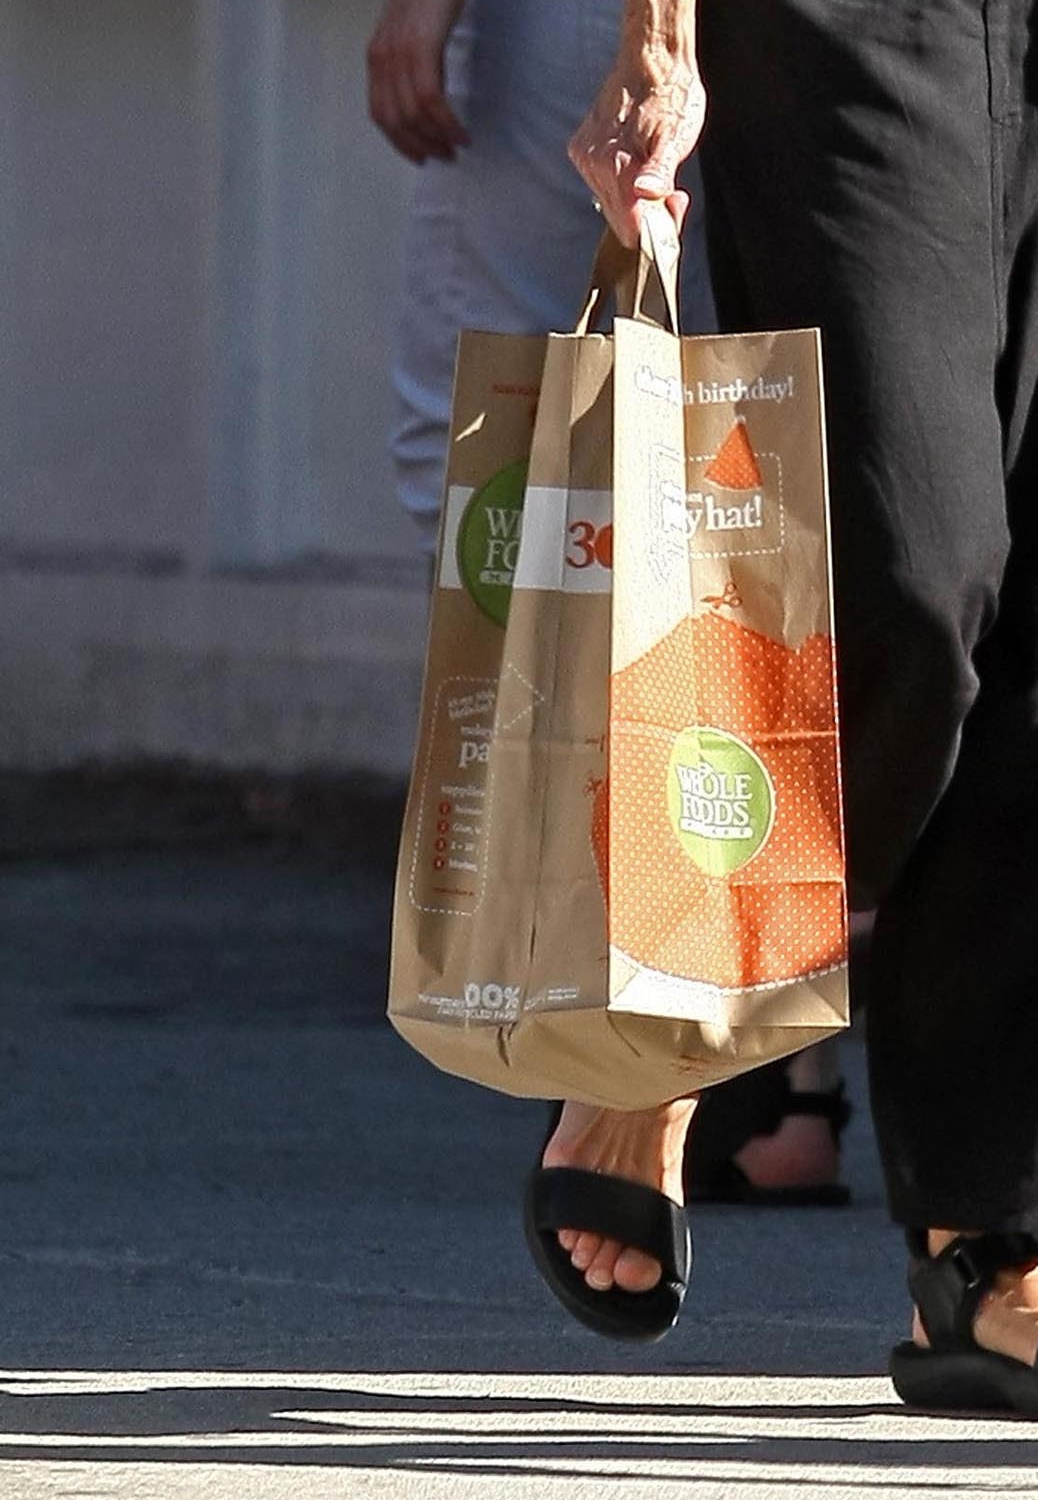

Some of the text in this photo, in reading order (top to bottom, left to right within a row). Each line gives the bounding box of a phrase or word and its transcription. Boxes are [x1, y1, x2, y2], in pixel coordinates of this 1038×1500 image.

[697, 375, 794, 404] birthday!
[704, 494, 763, 532] hat!
[458, 740, 490, 769] pa
